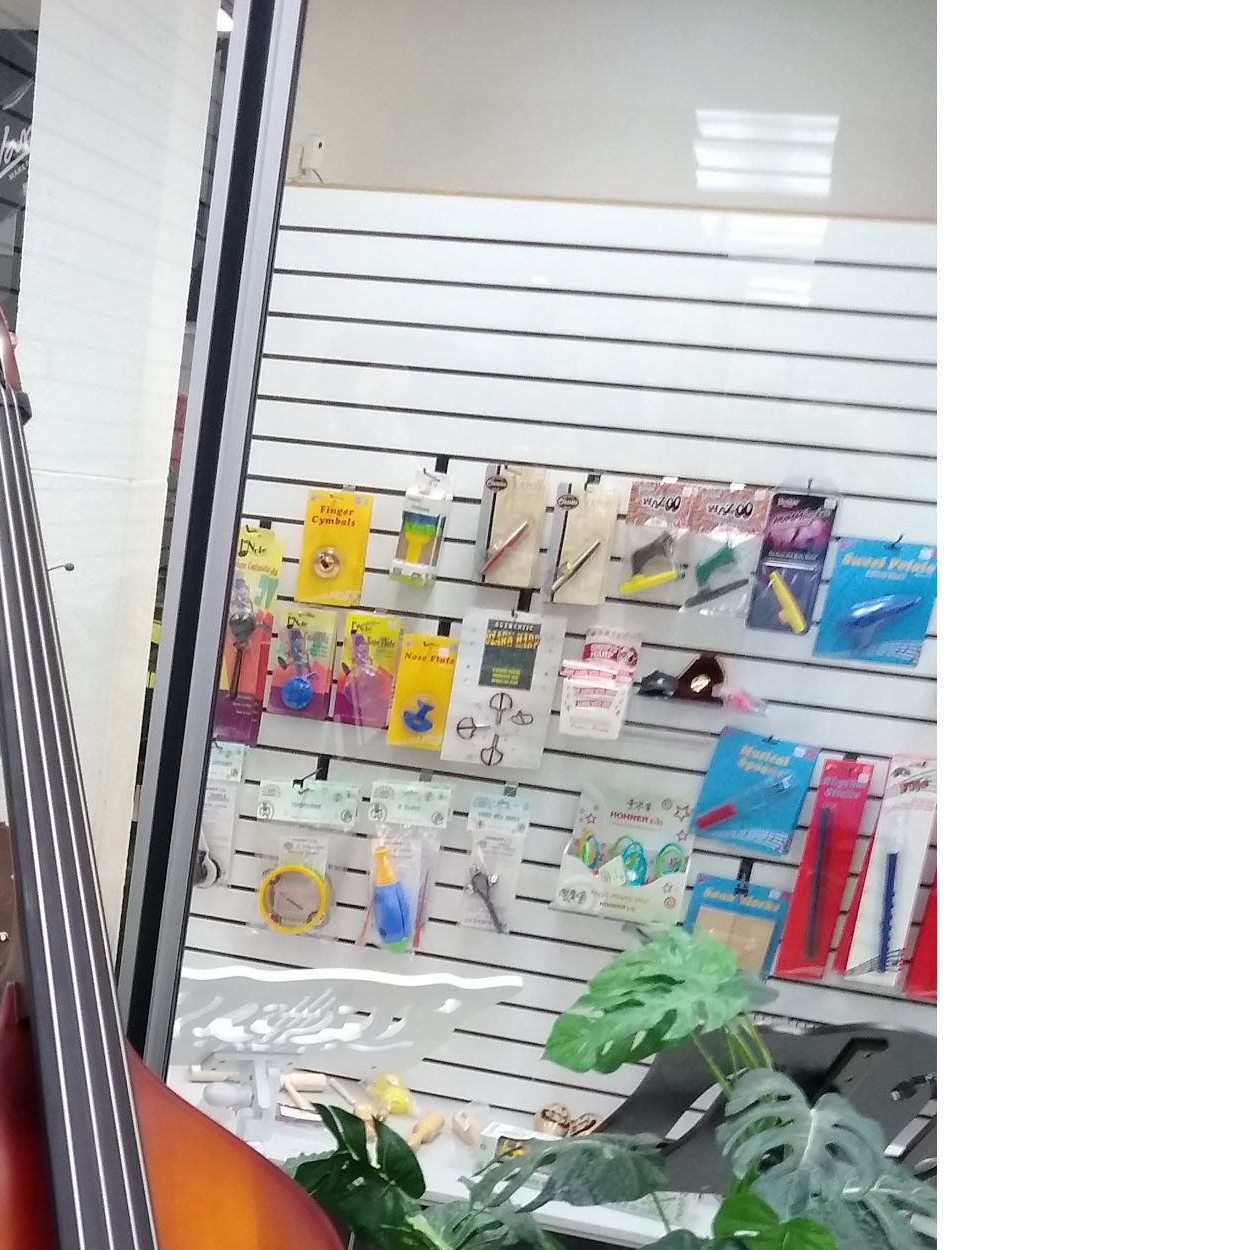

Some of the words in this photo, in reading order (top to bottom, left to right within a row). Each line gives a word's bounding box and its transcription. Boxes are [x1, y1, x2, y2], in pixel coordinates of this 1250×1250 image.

[320, 504, 354, 516] Finger
[311, 515, 356, 527] Cymbals
[494, 621, 534, 631] AUTHENTIC
[516, 632, 540, 650] HARP
[405, 652, 427, 661] Nose
[430, 655, 455, 664] Flute
[610, 811, 649, 824] HOHNER
